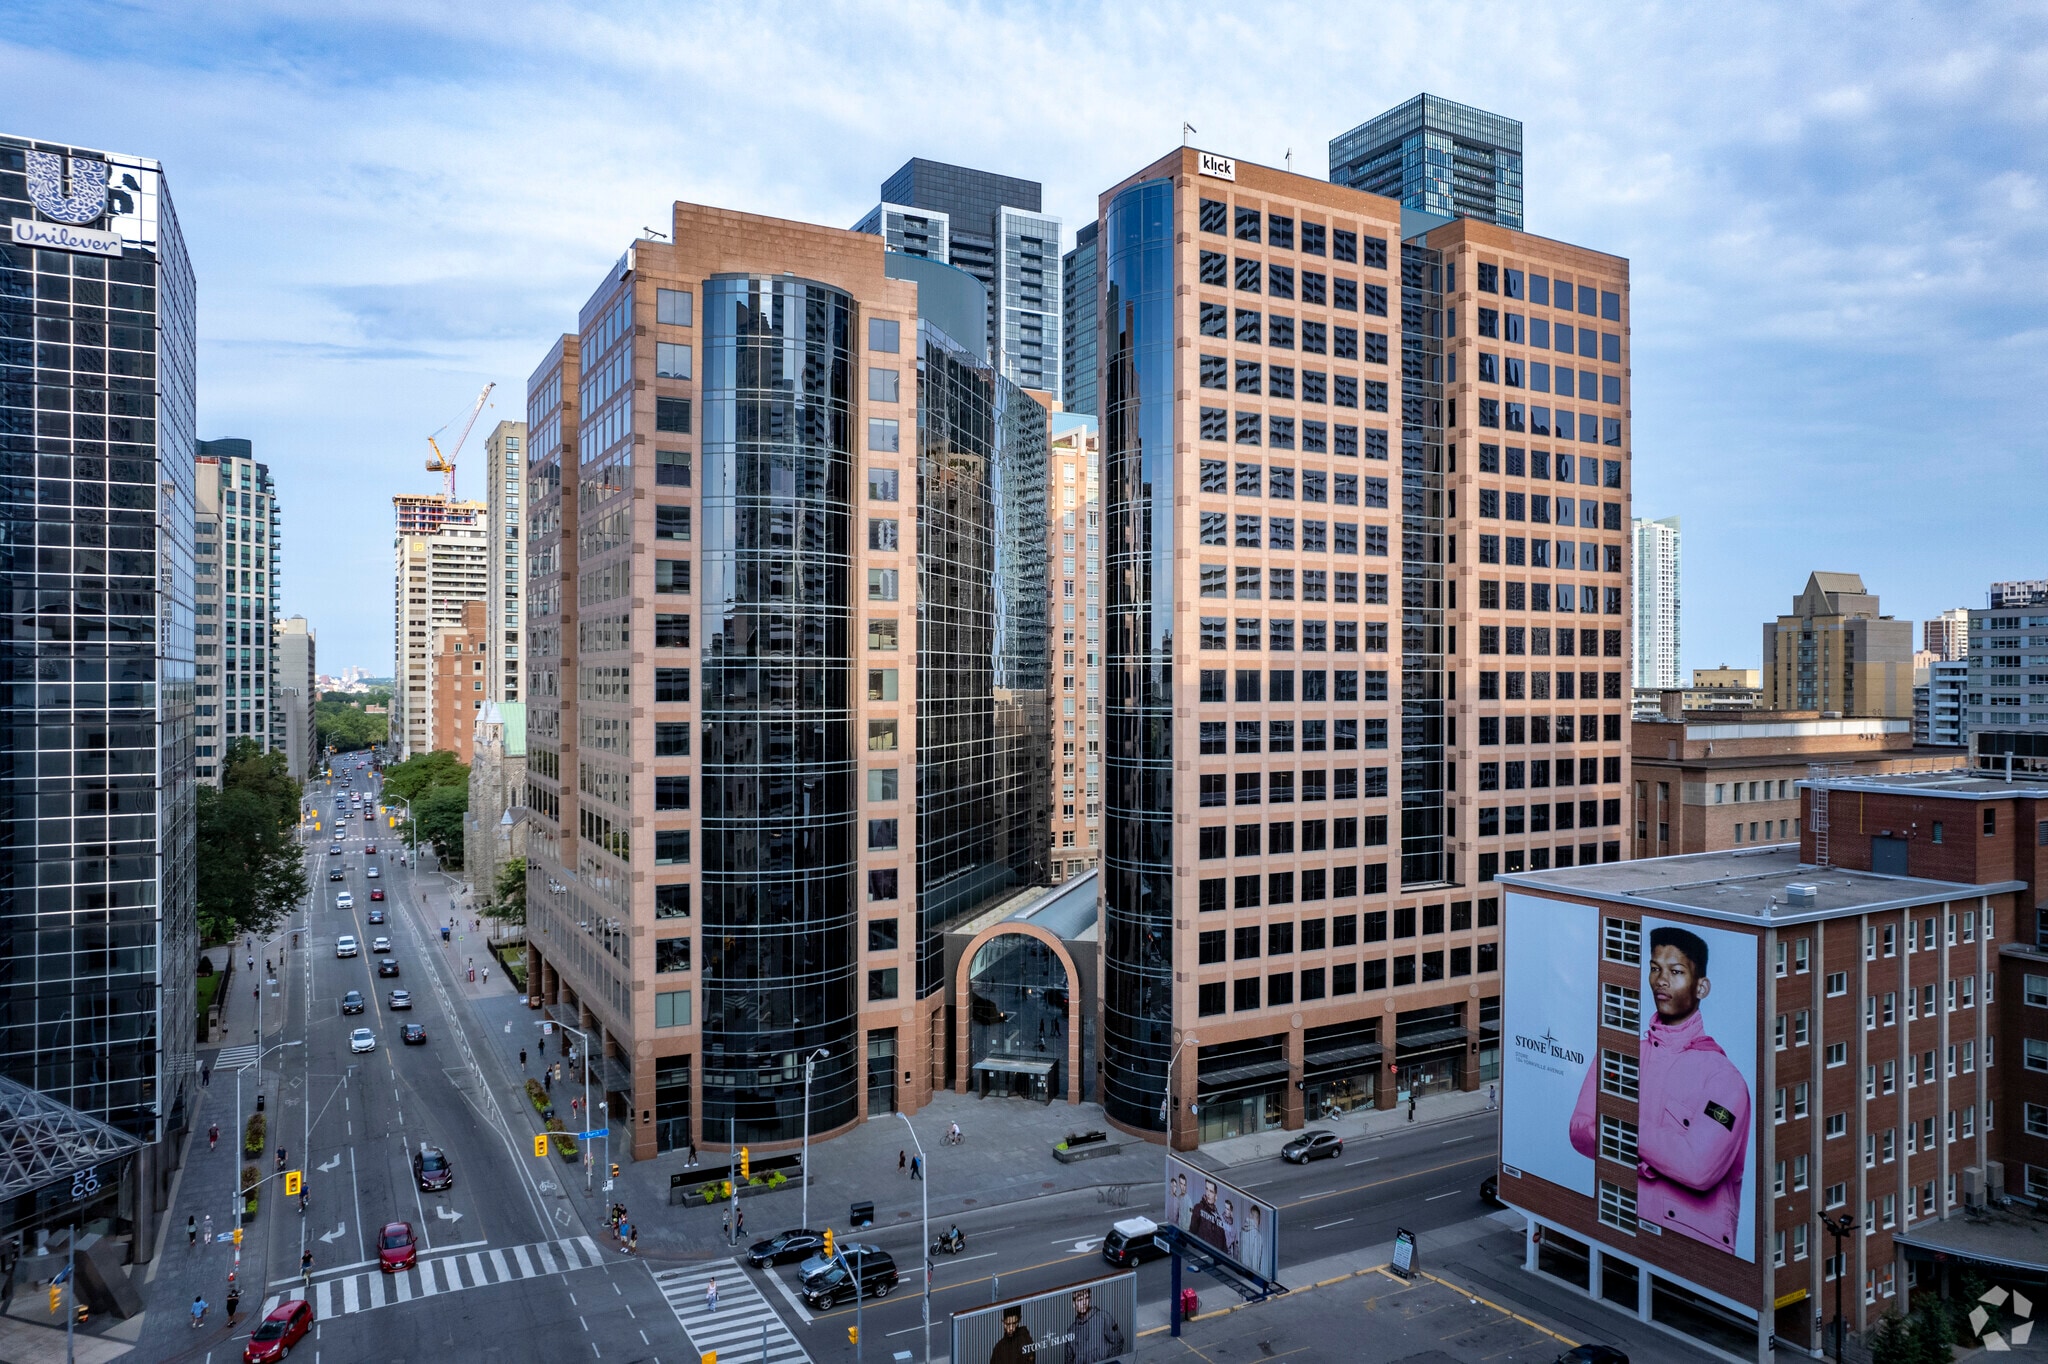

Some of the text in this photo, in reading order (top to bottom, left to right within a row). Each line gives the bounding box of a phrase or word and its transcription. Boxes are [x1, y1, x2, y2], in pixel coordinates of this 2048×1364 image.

[1203, 154, 1231, 174] klick
[16, 223, 118, 251] Unilever
[1515, 1035, 1584, 1065] STONE ISLAND
[72, 1165, 97, 1185] PI
[71, 1179, 101, 1197] CO.
[1051, 1332, 1075, 1347] ISLAND
